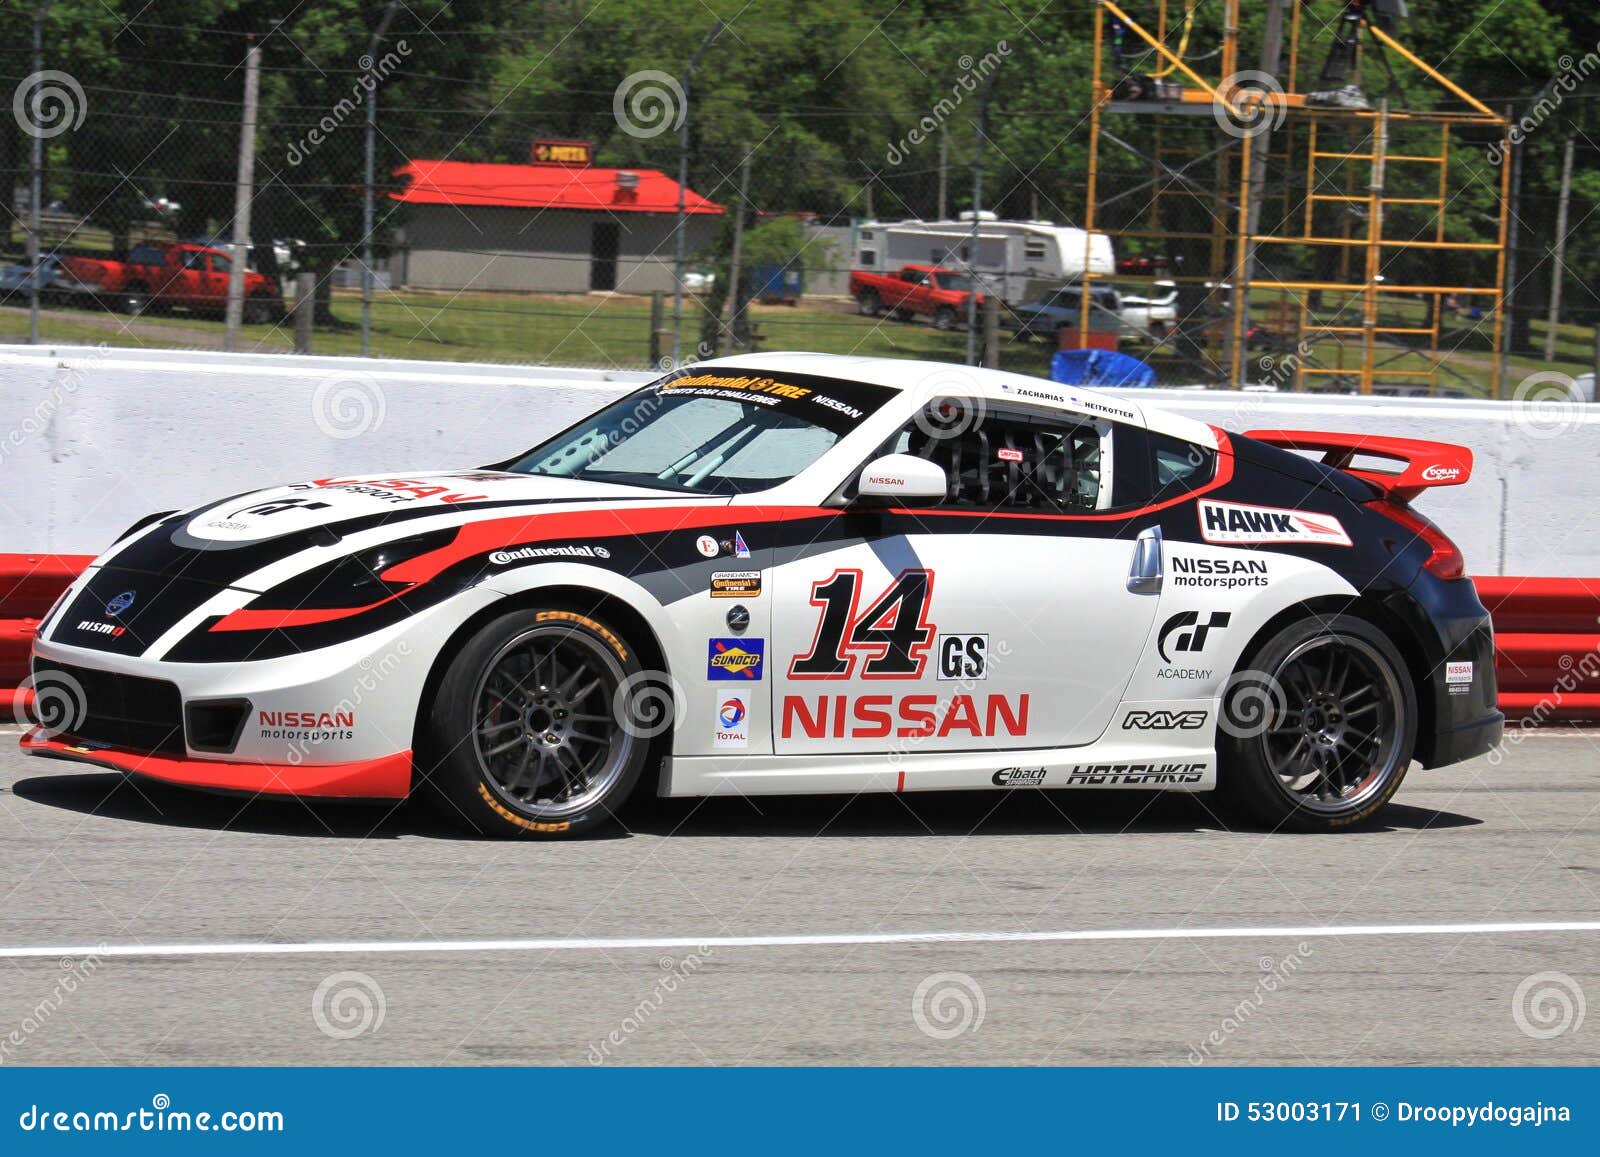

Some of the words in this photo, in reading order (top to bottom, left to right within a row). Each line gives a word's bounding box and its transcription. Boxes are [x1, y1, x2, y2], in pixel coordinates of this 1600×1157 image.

[694, 388, 720, 396] CAR
[716, 389, 782, 406] CHALLENGE
[763, 382, 812, 399] TIRE
[1016, 388, 1065, 403] ZACHARIAS
[811, 394, 864, 419] NISSAN
[1084, 401, 1134, 419] HEITKOTTER
[868, 476, 905, 486] NISSAN
[1204, 505, 1299, 533] HAWK
[488, 545, 597, 565] Continental
[1172, 557, 1268, 574] NISSAN
[1174, 575, 1269, 589] motorsports
[787, 568, 937, 680] 14
[712, 655, 758, 666] SUNOCO
[941, 636, 985, 678] GS
[1156, 668, 1213, 680] ACADEMY
[1448, 666, 1472, 674] NISSAN
[259, 711, 354, 728] NISSAN
[781, 694, 1030, 738] NISSAN
[1122, 711, 1208, 730] RAYS
[260, 729, 353, 741] motorsports
[992, 766, 1047, 785] Eibach
[1066, 763, 1207, 785] HOTCHKIS
